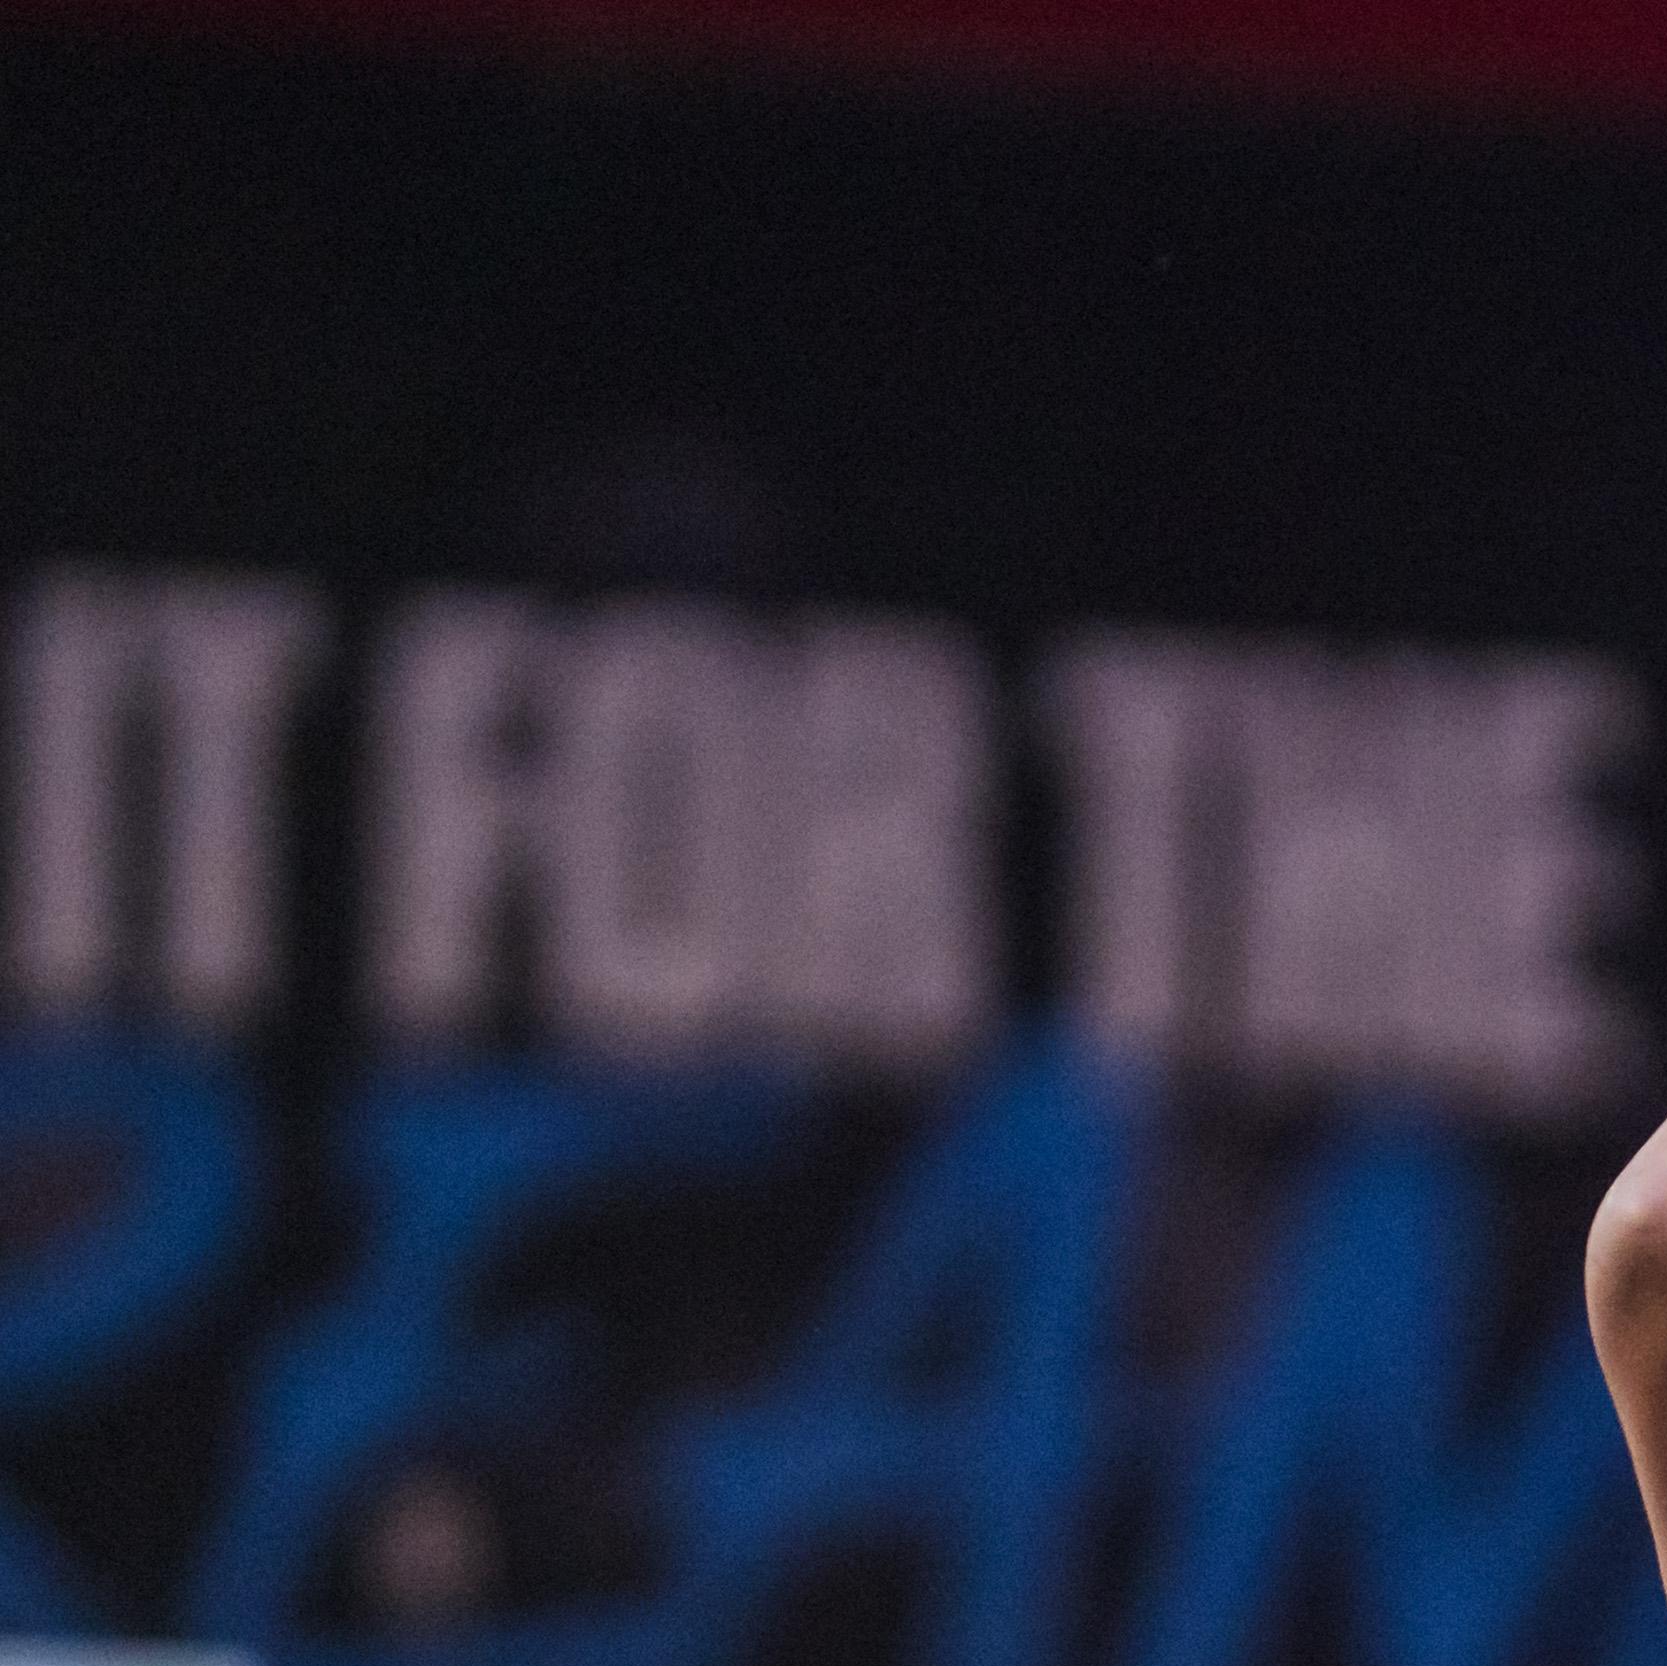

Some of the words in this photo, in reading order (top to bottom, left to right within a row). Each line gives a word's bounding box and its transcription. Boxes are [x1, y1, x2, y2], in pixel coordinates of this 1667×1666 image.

[18, 575, 325, 1005] IT
[375, 590, 995, 1065] FOR
[1045, 630, 1645, 1105] THE
